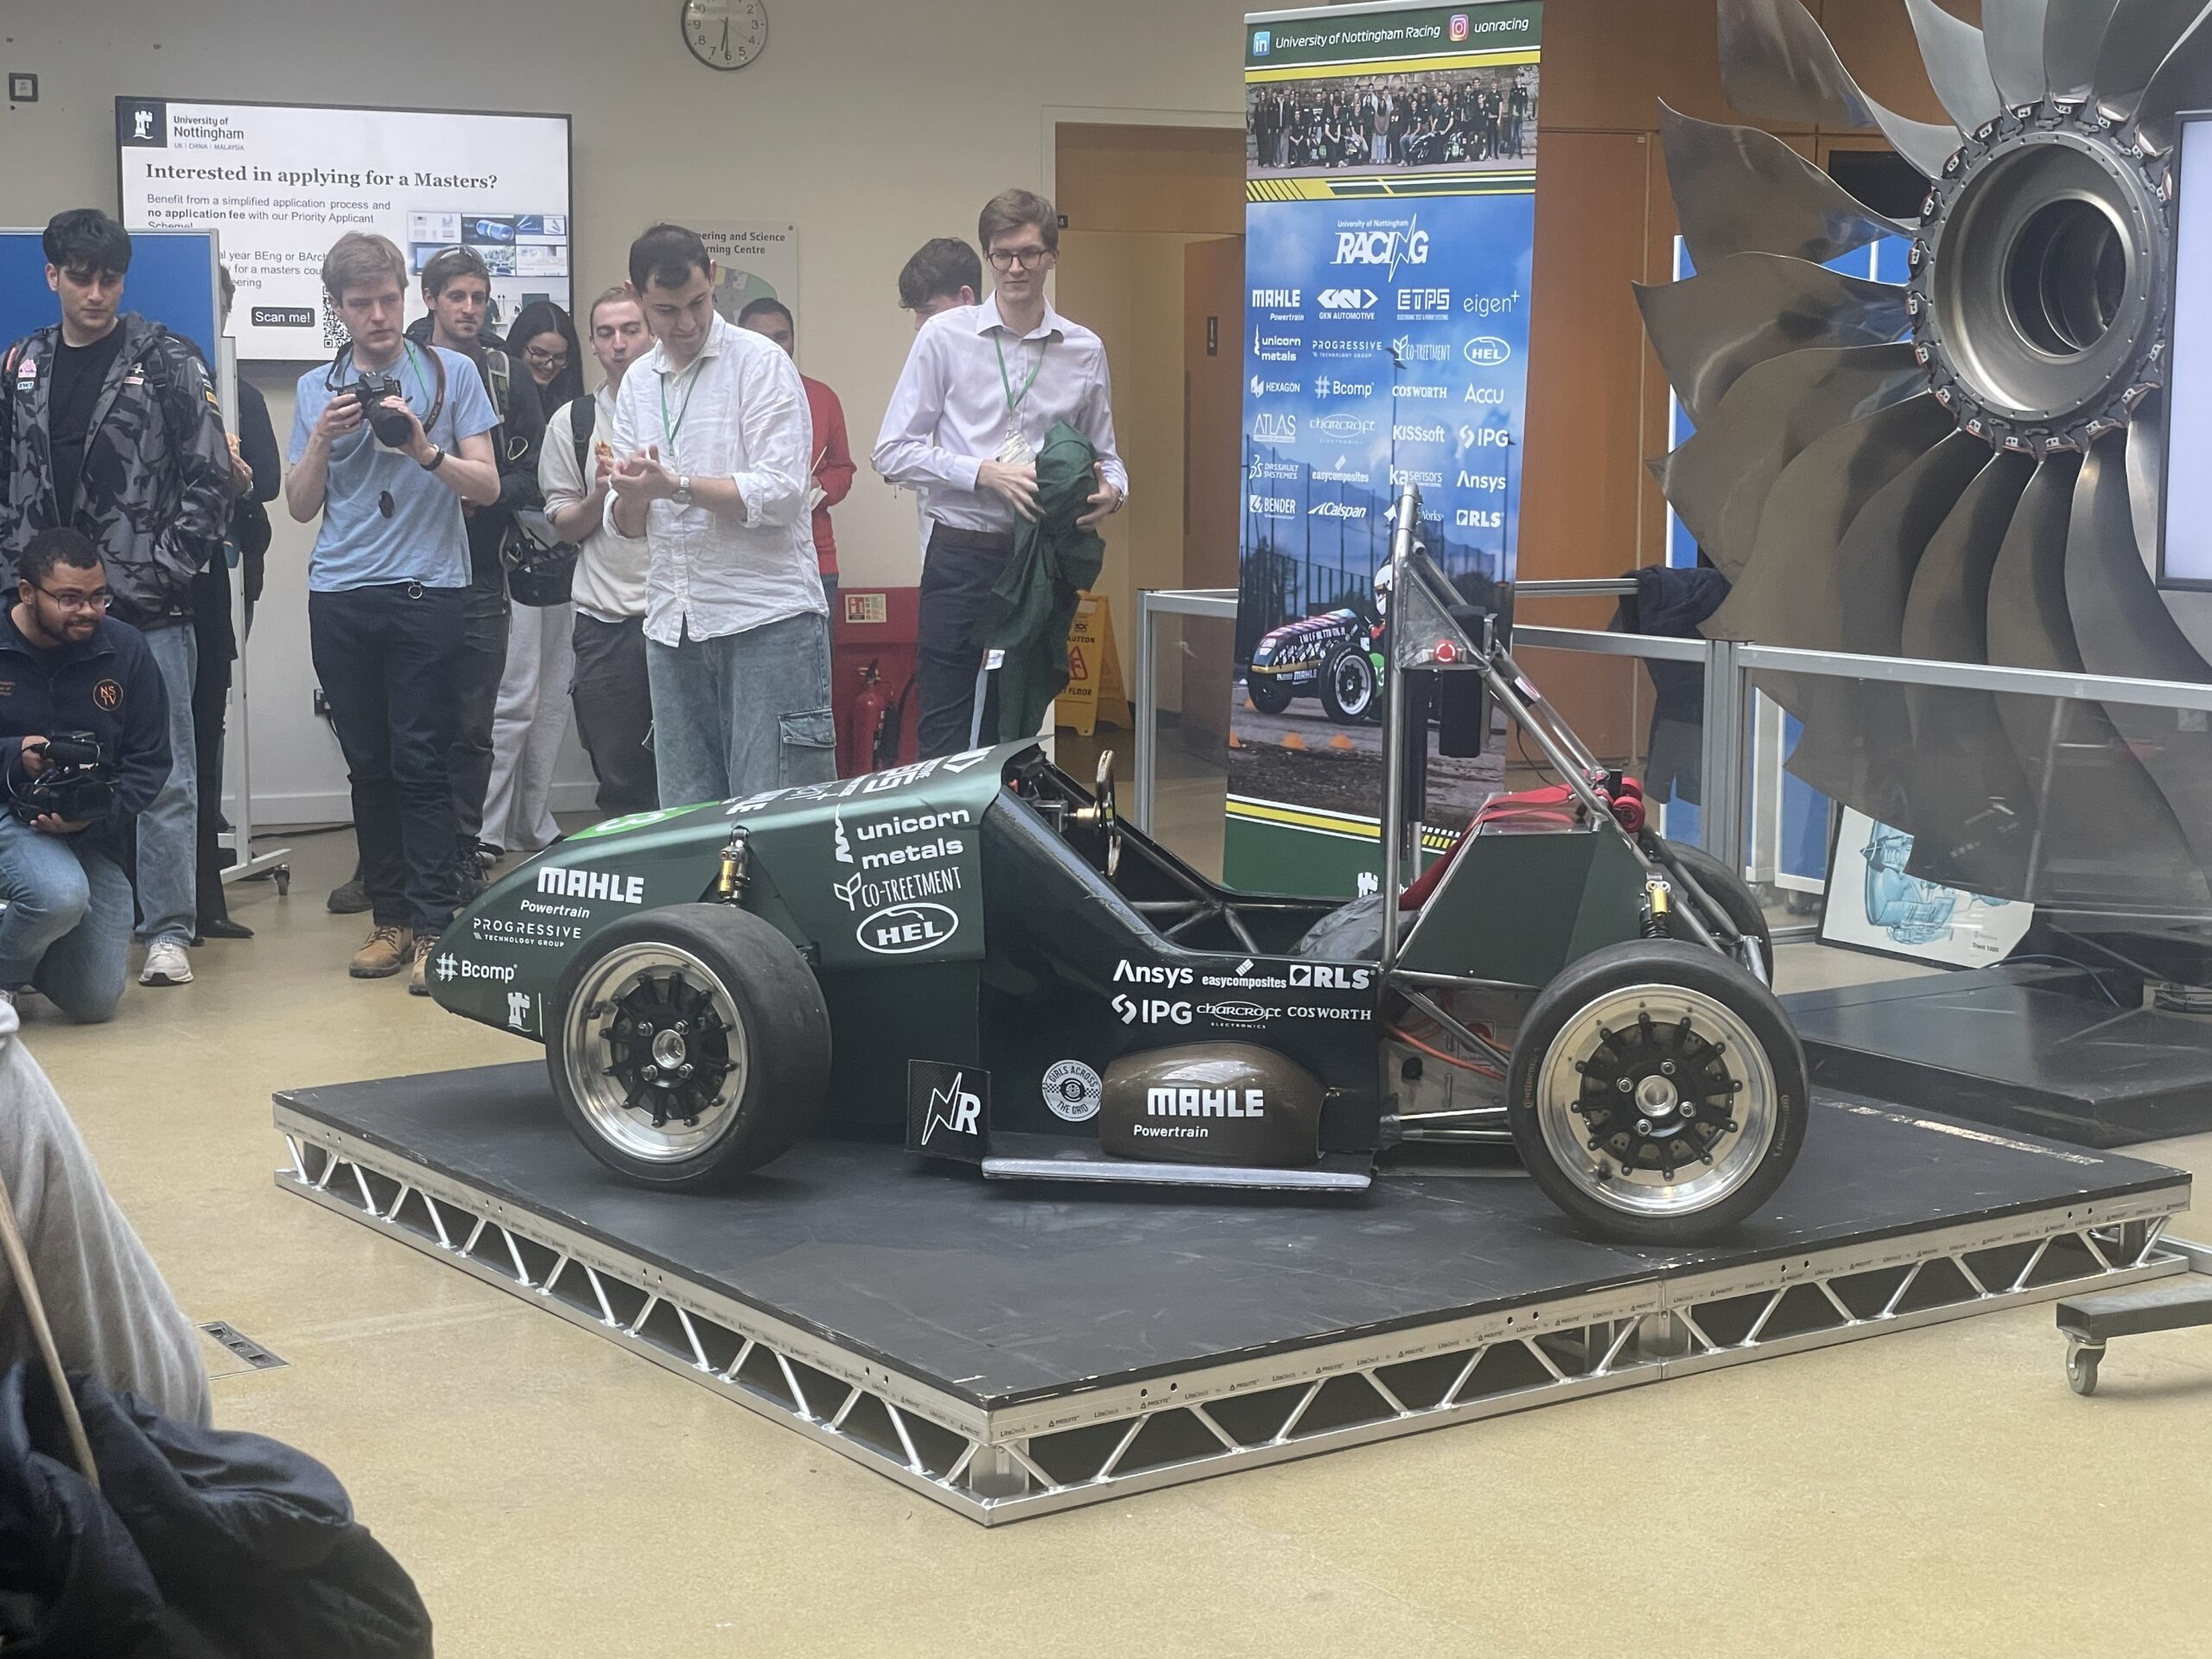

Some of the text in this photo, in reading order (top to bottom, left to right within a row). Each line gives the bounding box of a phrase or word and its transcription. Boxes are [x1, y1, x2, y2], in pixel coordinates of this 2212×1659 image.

[747, 4, 753, 14] 2
[694, 20, 701, 29] 9
[752, 20, 759, 29] 3
[1474, 17, 1529, 35] uonracing
[698, 35, 705, 45] 8
[748, 35, 755, 45] 4
[1275, 24, 1440, 48] University of Nottingham Racing
[709, 47, 716, 55] 7
[739, 47, 746, 56] 5
[174, 116, 229, 127] University of
[174, 126, 245, 141] Nottingham
[146, 163, 498, 189] Interested in applying for a Masters?
[147, 194, 184, 205] Benefit
[186, 194, 210, 206] from
[222, 195, 270, 209] simplified
[273, 198, 326, 210] application
[330, 200, 369, 212] process
[372, 200, 391, 211] and
[165, 208, 227, 221] application
[228, 210, 246, 220] fee
[248, 211, 269, 220] with
[271, 213, 288, 221] our
[290, 212, 326, 225] Priority
[328, 213, 374, 225] Applicant
[1338, 219, 1364, 229] University
[1373, 219, 1409, 229] Nottingham
[698, 231, 785, 242] eering and Science
[706, 245, 766, 255] rning Centre
[1330, 222, 1429, 270] RACING
[229, 251, 251, 262] year
[254, 251, 282, 262] BEng
[234, 265, 248, 274] for
[261, 267, 301, 276] masters
[1253, 289, 1300, 308] MAHLE
[1398, 289, 1450, 310] ETPS
[255, 311, 310, 323] Scan me!
[1270, 313, 1304, 321] Powertrain
[1262, 335, 1301, 346] unicorn
[1313, 340, 1382, 351] PROGRESSIVE
[1262, 351, 1296, 361] metals
[1407, 345, 1450, 361] CO-TREETMENT
[1472, 348, 1501, 359] HEL
[1266, 383, 1300, 393] HEXAGON
[1392, 385, 1447, 398] COSWORTH
[1254, 414, 1295, 435] ATLAS
[1393, 424, 1445, 443] KISSsoft
[1478, 429, 1509, 448] IPG
[1313, 471, 1370, 483] easycomposites
[1456, 470, 1506, 493] Ansys
[1264, 498, 1295, 514] BENDER
[1324, 502, 1366, 519] Calspan
[858, 809, 969, 841] unicorn
[862, 837, 964, 870] metals
[537, 867, 645, 904] MAHLE
[862, 866, 962, 909] CO-TREETMENT
[520, 899, 590, 918] Powertrain
[474, 918, 582, 939] PROGRESSIVE
[876, 920, 944, 946] HEL
[484, 934, 564, 947] TECHNOLOGY GROUP
[1113, 959, 1193, 988] Ansys
[1202, 975, 1287, 989] easycomposites
[1142, 1000, 1192, 1025] IPG
[1197, 1003, 1281, 1020] charcroft
[1287, 1007, 1372, 1020] COSWORTH
[1049, 1065, 1098, 1087] GIRLS ACROSS
[1057, 1101, 1089, 1115] THE GRID
[1147, 1088, 1263, 1117] MAHLE
[1133, 1124, 1209, 1138] Powertrain
